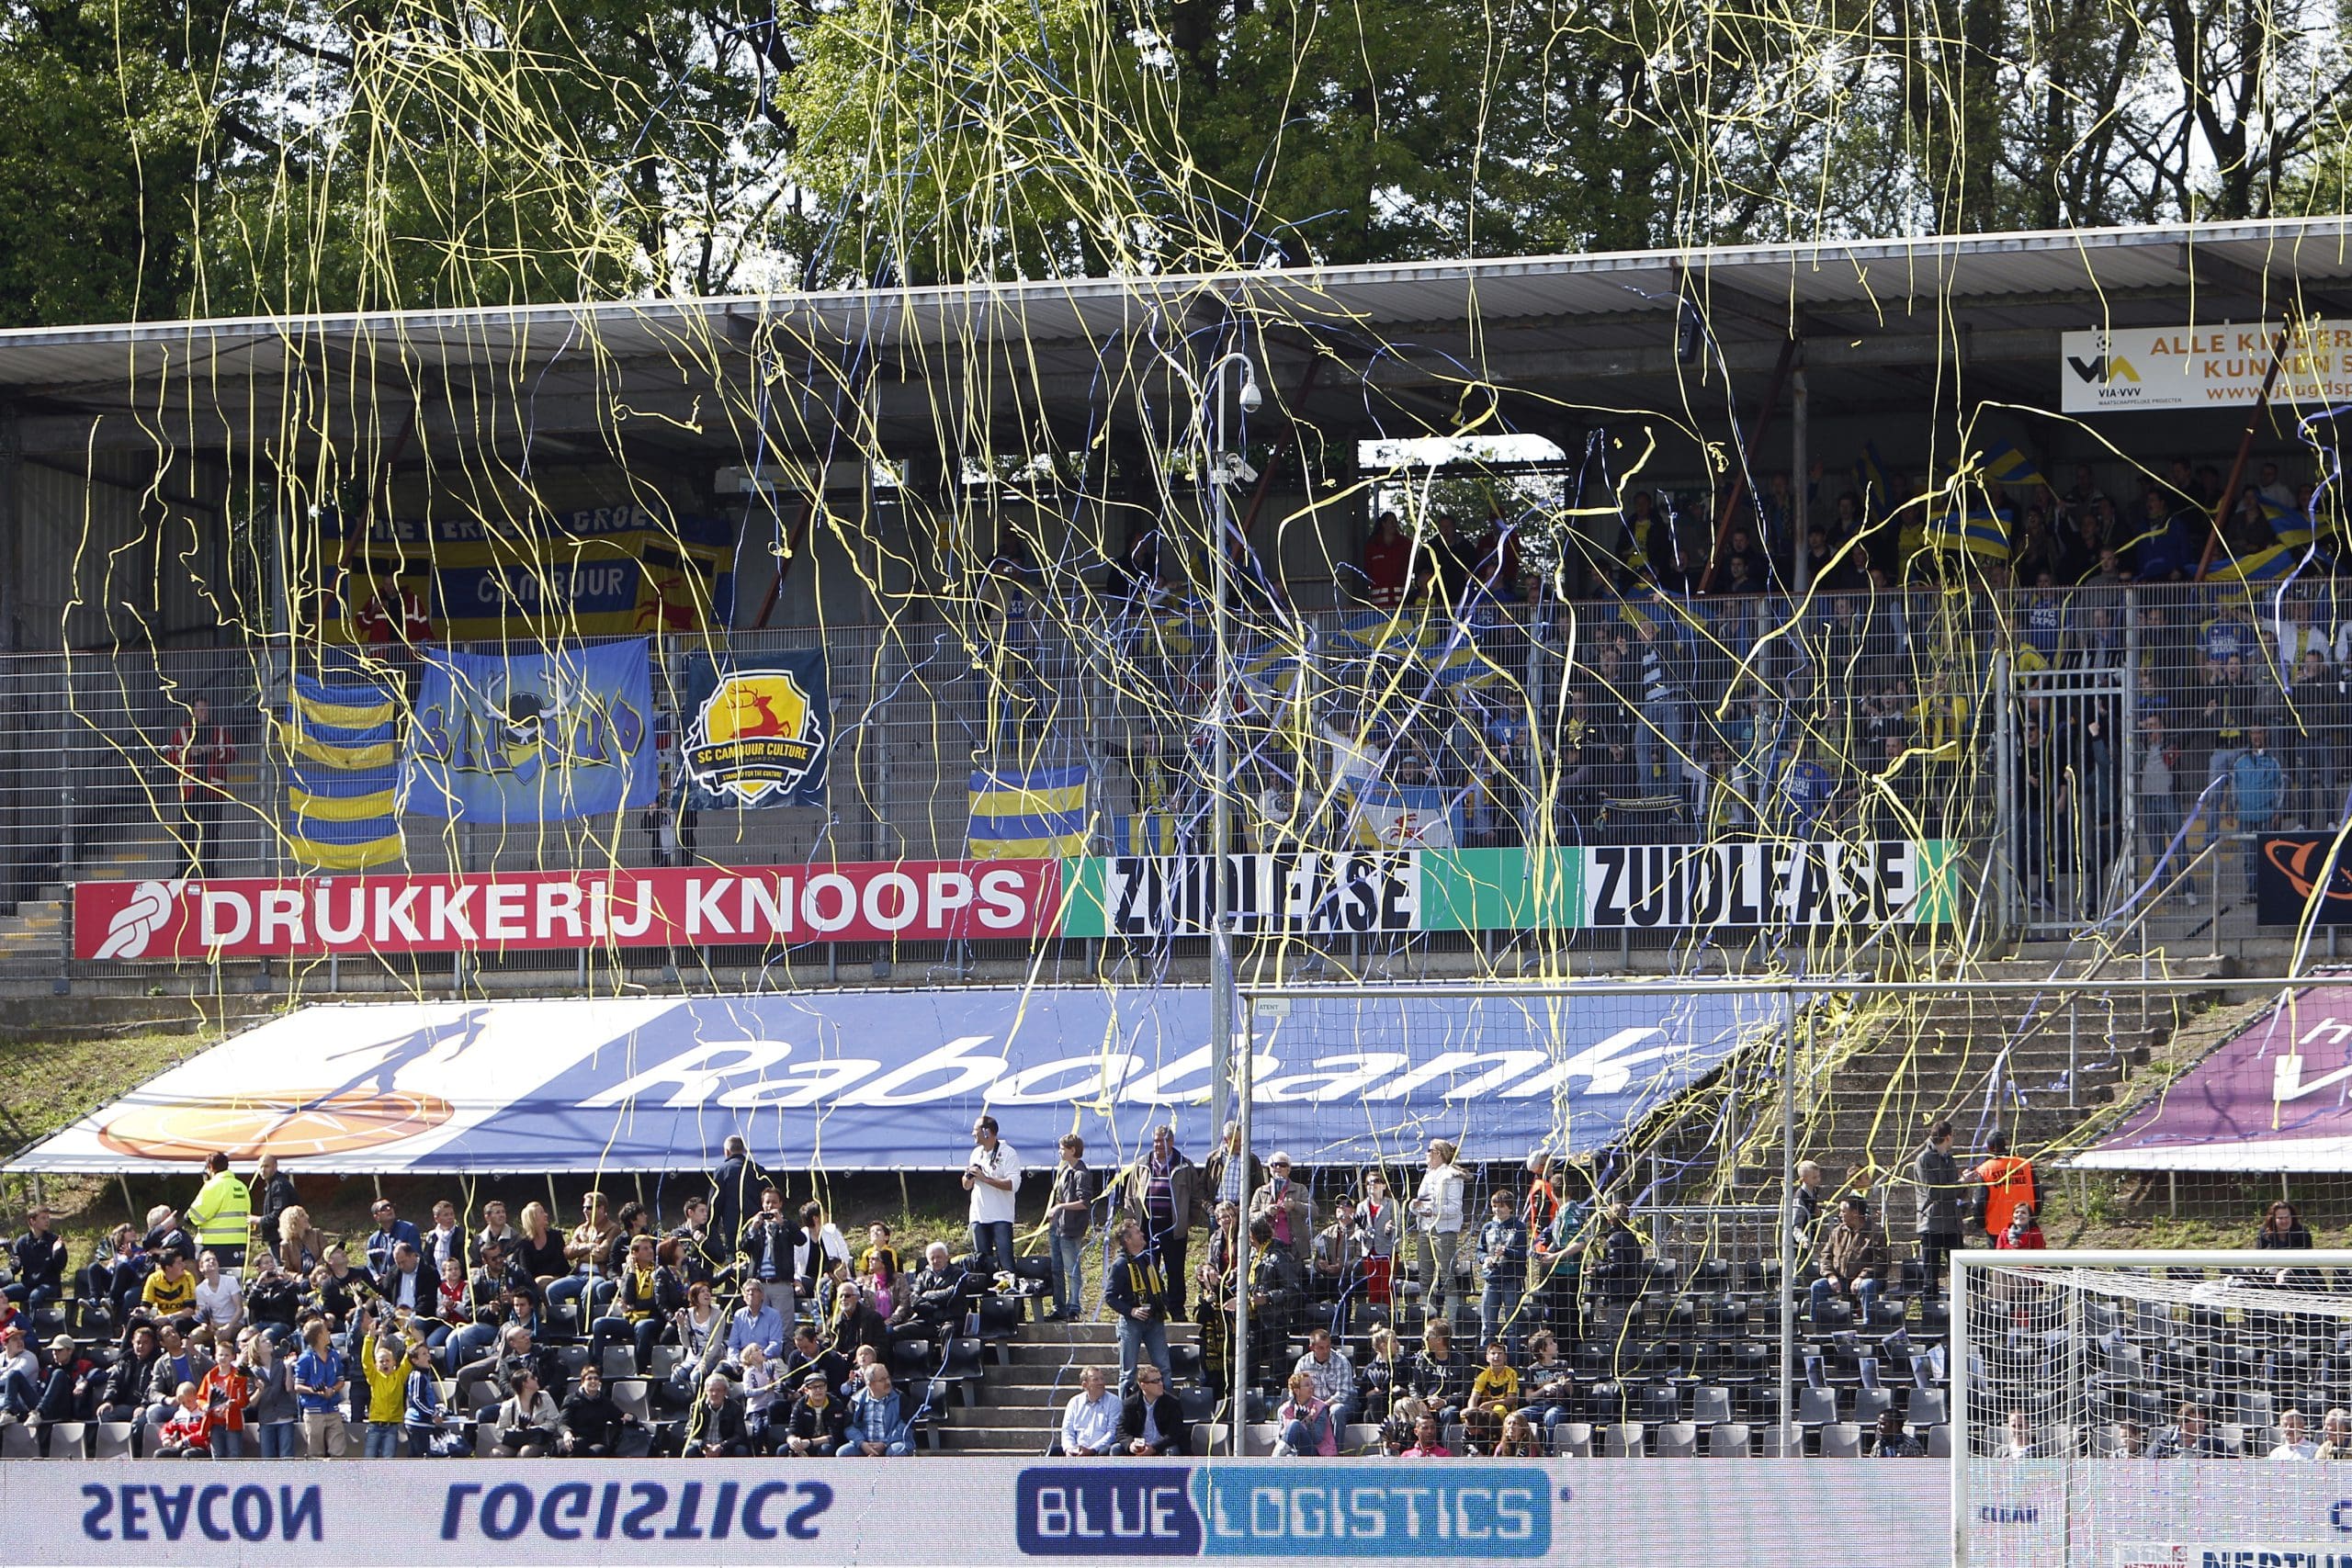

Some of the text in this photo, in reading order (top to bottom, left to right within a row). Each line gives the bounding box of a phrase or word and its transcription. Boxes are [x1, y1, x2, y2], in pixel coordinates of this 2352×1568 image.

[2151, 333, 2225, 355] ALLE
[697, 742, 808, 764] SC CAMBUUR CULTURE
[200, 869, 1025, 946] DRUKKERIJ KNOOPS
[1114, 851, 1410, 934] ZUIDLEASE
[1594, 842, 1905, 927] ZUIDLEASE
[573, 1027, 1700, 1108] Rabobank
[1036, 1486, 1534, 1539] BLUE LOGISTICS
